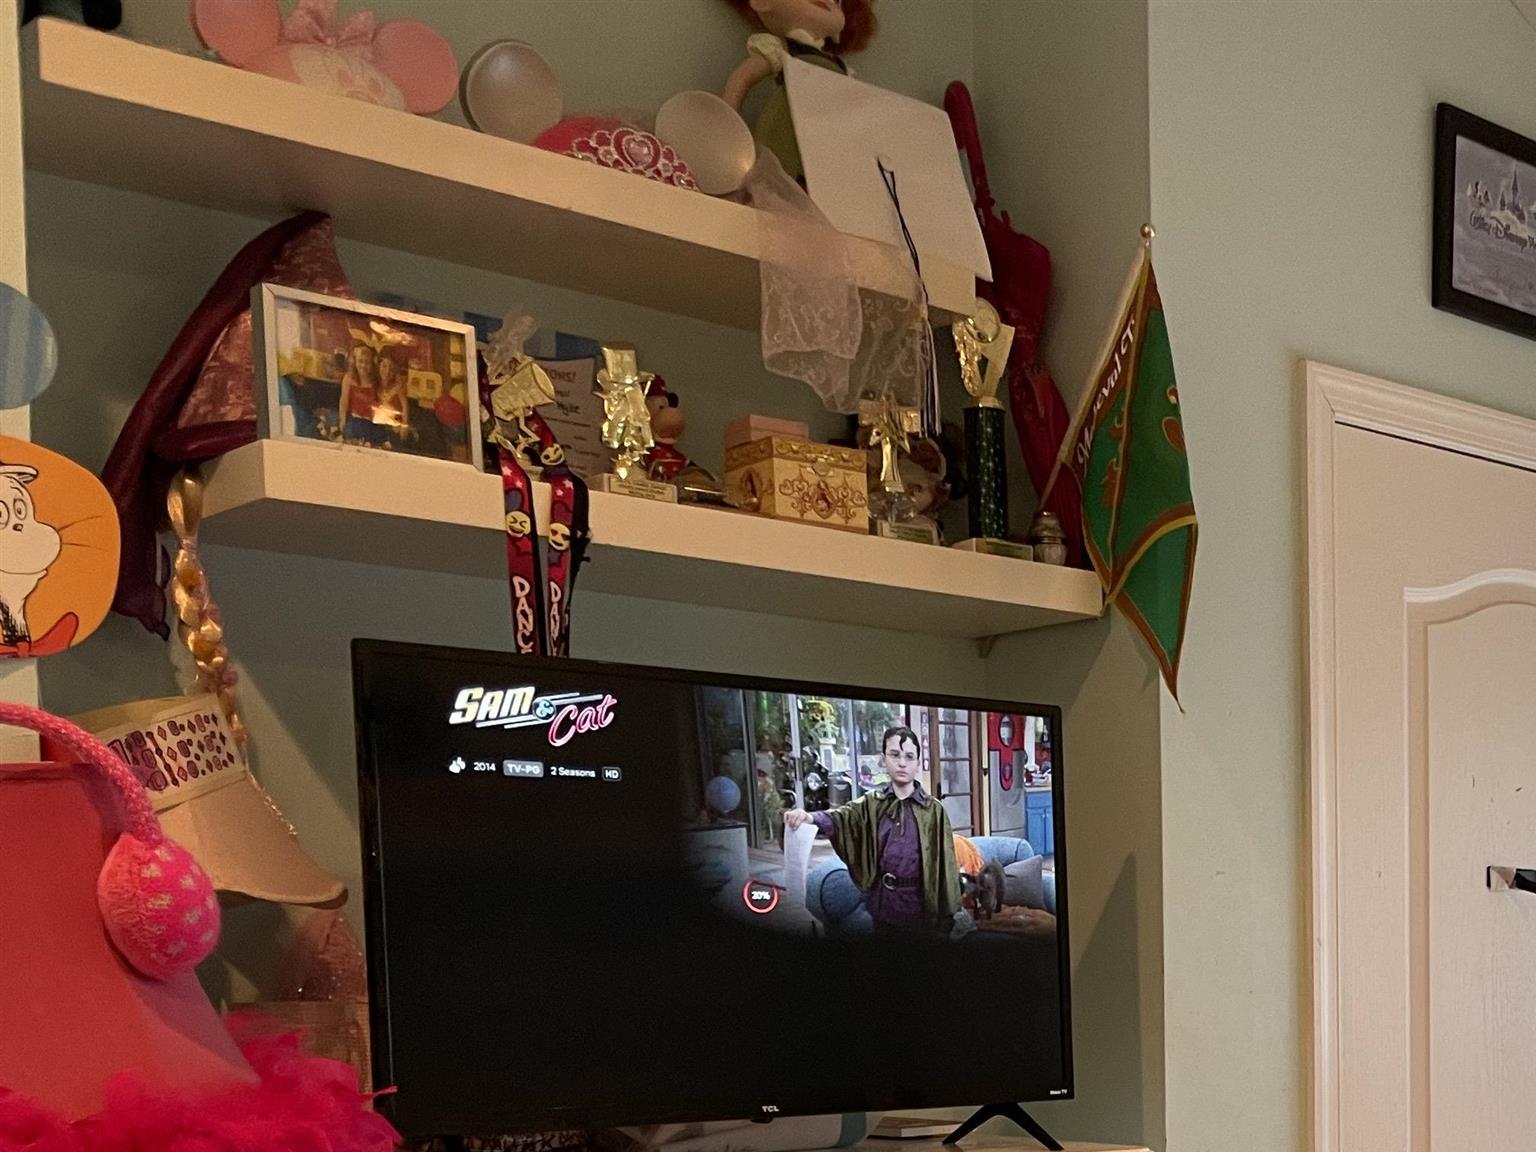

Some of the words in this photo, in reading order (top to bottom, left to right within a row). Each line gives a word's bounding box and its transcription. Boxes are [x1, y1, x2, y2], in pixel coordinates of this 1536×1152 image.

[512, 575, 534, 654] DANC
[548, 694, 617, 747] Cat
[473, 761, 496, 772] 2014
[507, 764, 541, 775] TV-PG
[550, 766, 557, 775] 2
[559, 767, 596, 778] Seasons
[605, 769, 619, 779] HD
